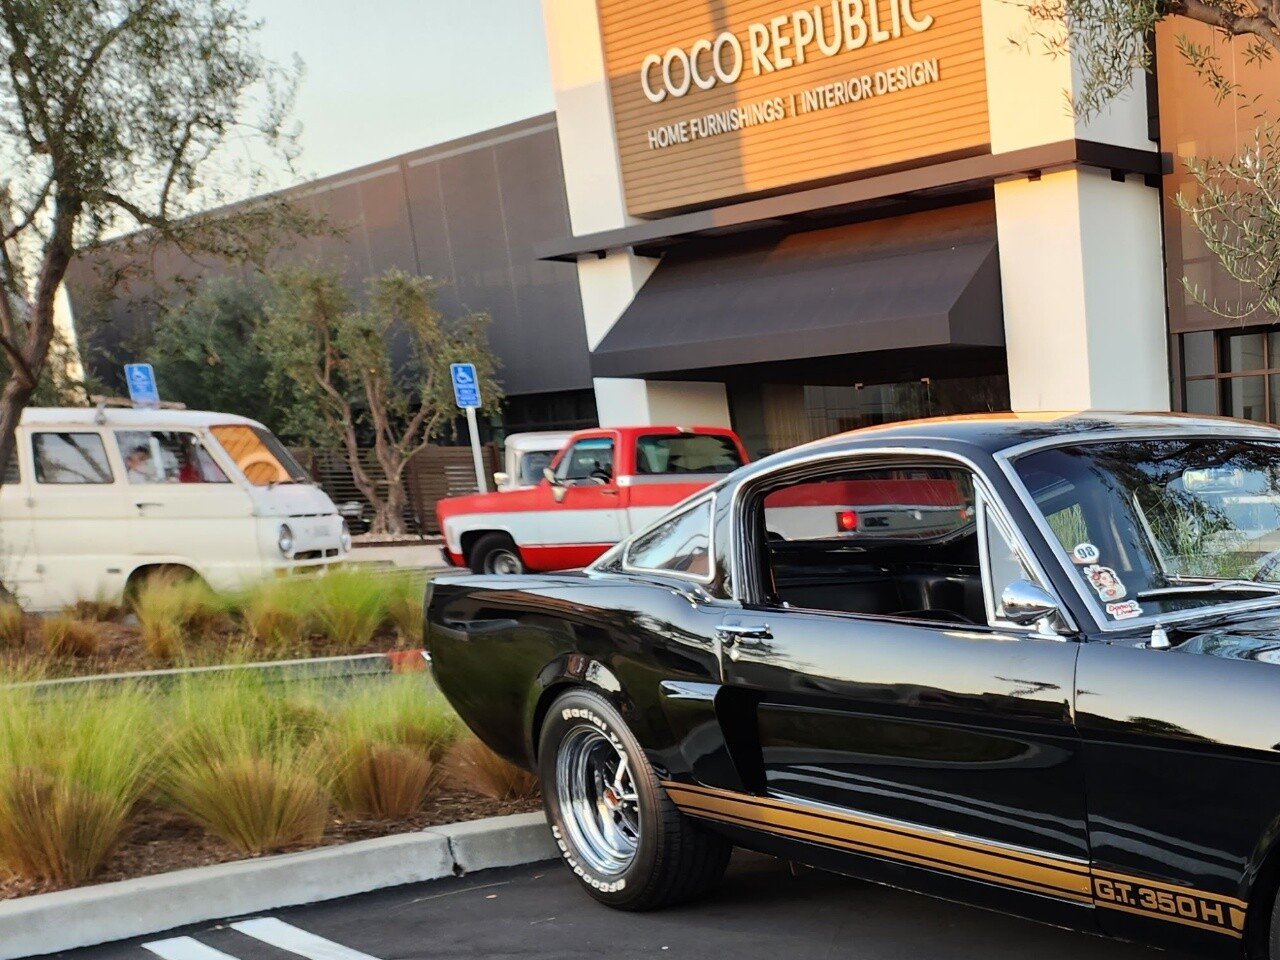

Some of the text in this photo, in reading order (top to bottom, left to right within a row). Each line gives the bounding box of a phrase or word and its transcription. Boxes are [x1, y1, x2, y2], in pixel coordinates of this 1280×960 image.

[641, 0, 934, 103] COCO REPUBLIC
[648, 121, 690, 149] HOME
[690, 97, 785, 140] FURNISHINGS
[801, 75, 875, 113] INTERIOR
[874, 57, 940, 96] DESIGN
[1076, 545, 1096, 559] 98
